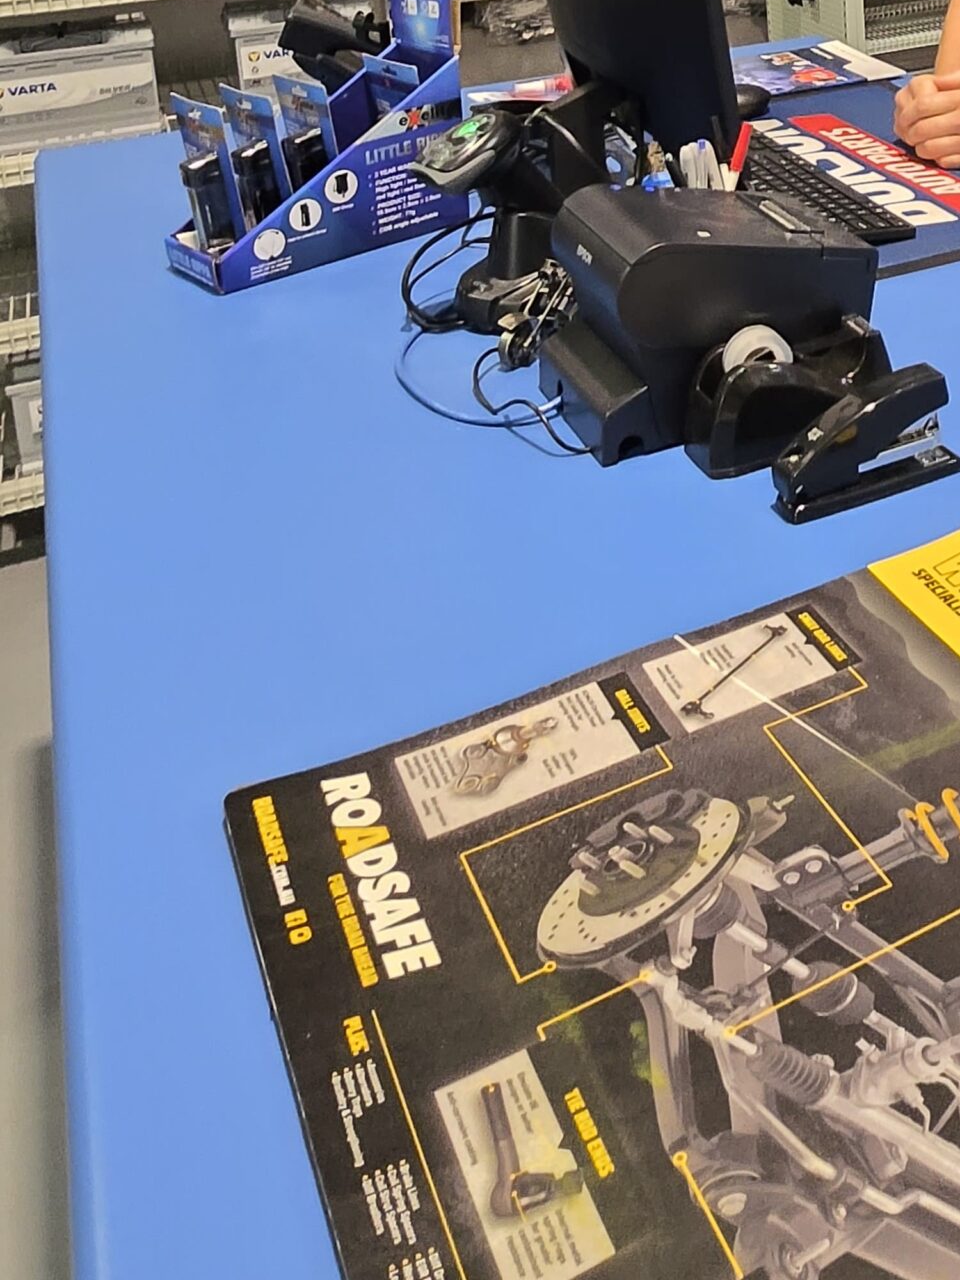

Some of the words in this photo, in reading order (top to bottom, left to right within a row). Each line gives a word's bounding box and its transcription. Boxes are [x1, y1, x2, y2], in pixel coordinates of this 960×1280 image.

[264, 50, 293, 60] VAR
[8, 82, 57, 96] VARTA
[365, 140, 412, 166] LITTLE
[819, 127, 893, 165] PARTS
[320, 772, 441, 979] ROADSAFE
[327, 873, 348, 898] FOR
[335, 895, 355, 919] THE
[564, 1087, 586, 1114] TIE
